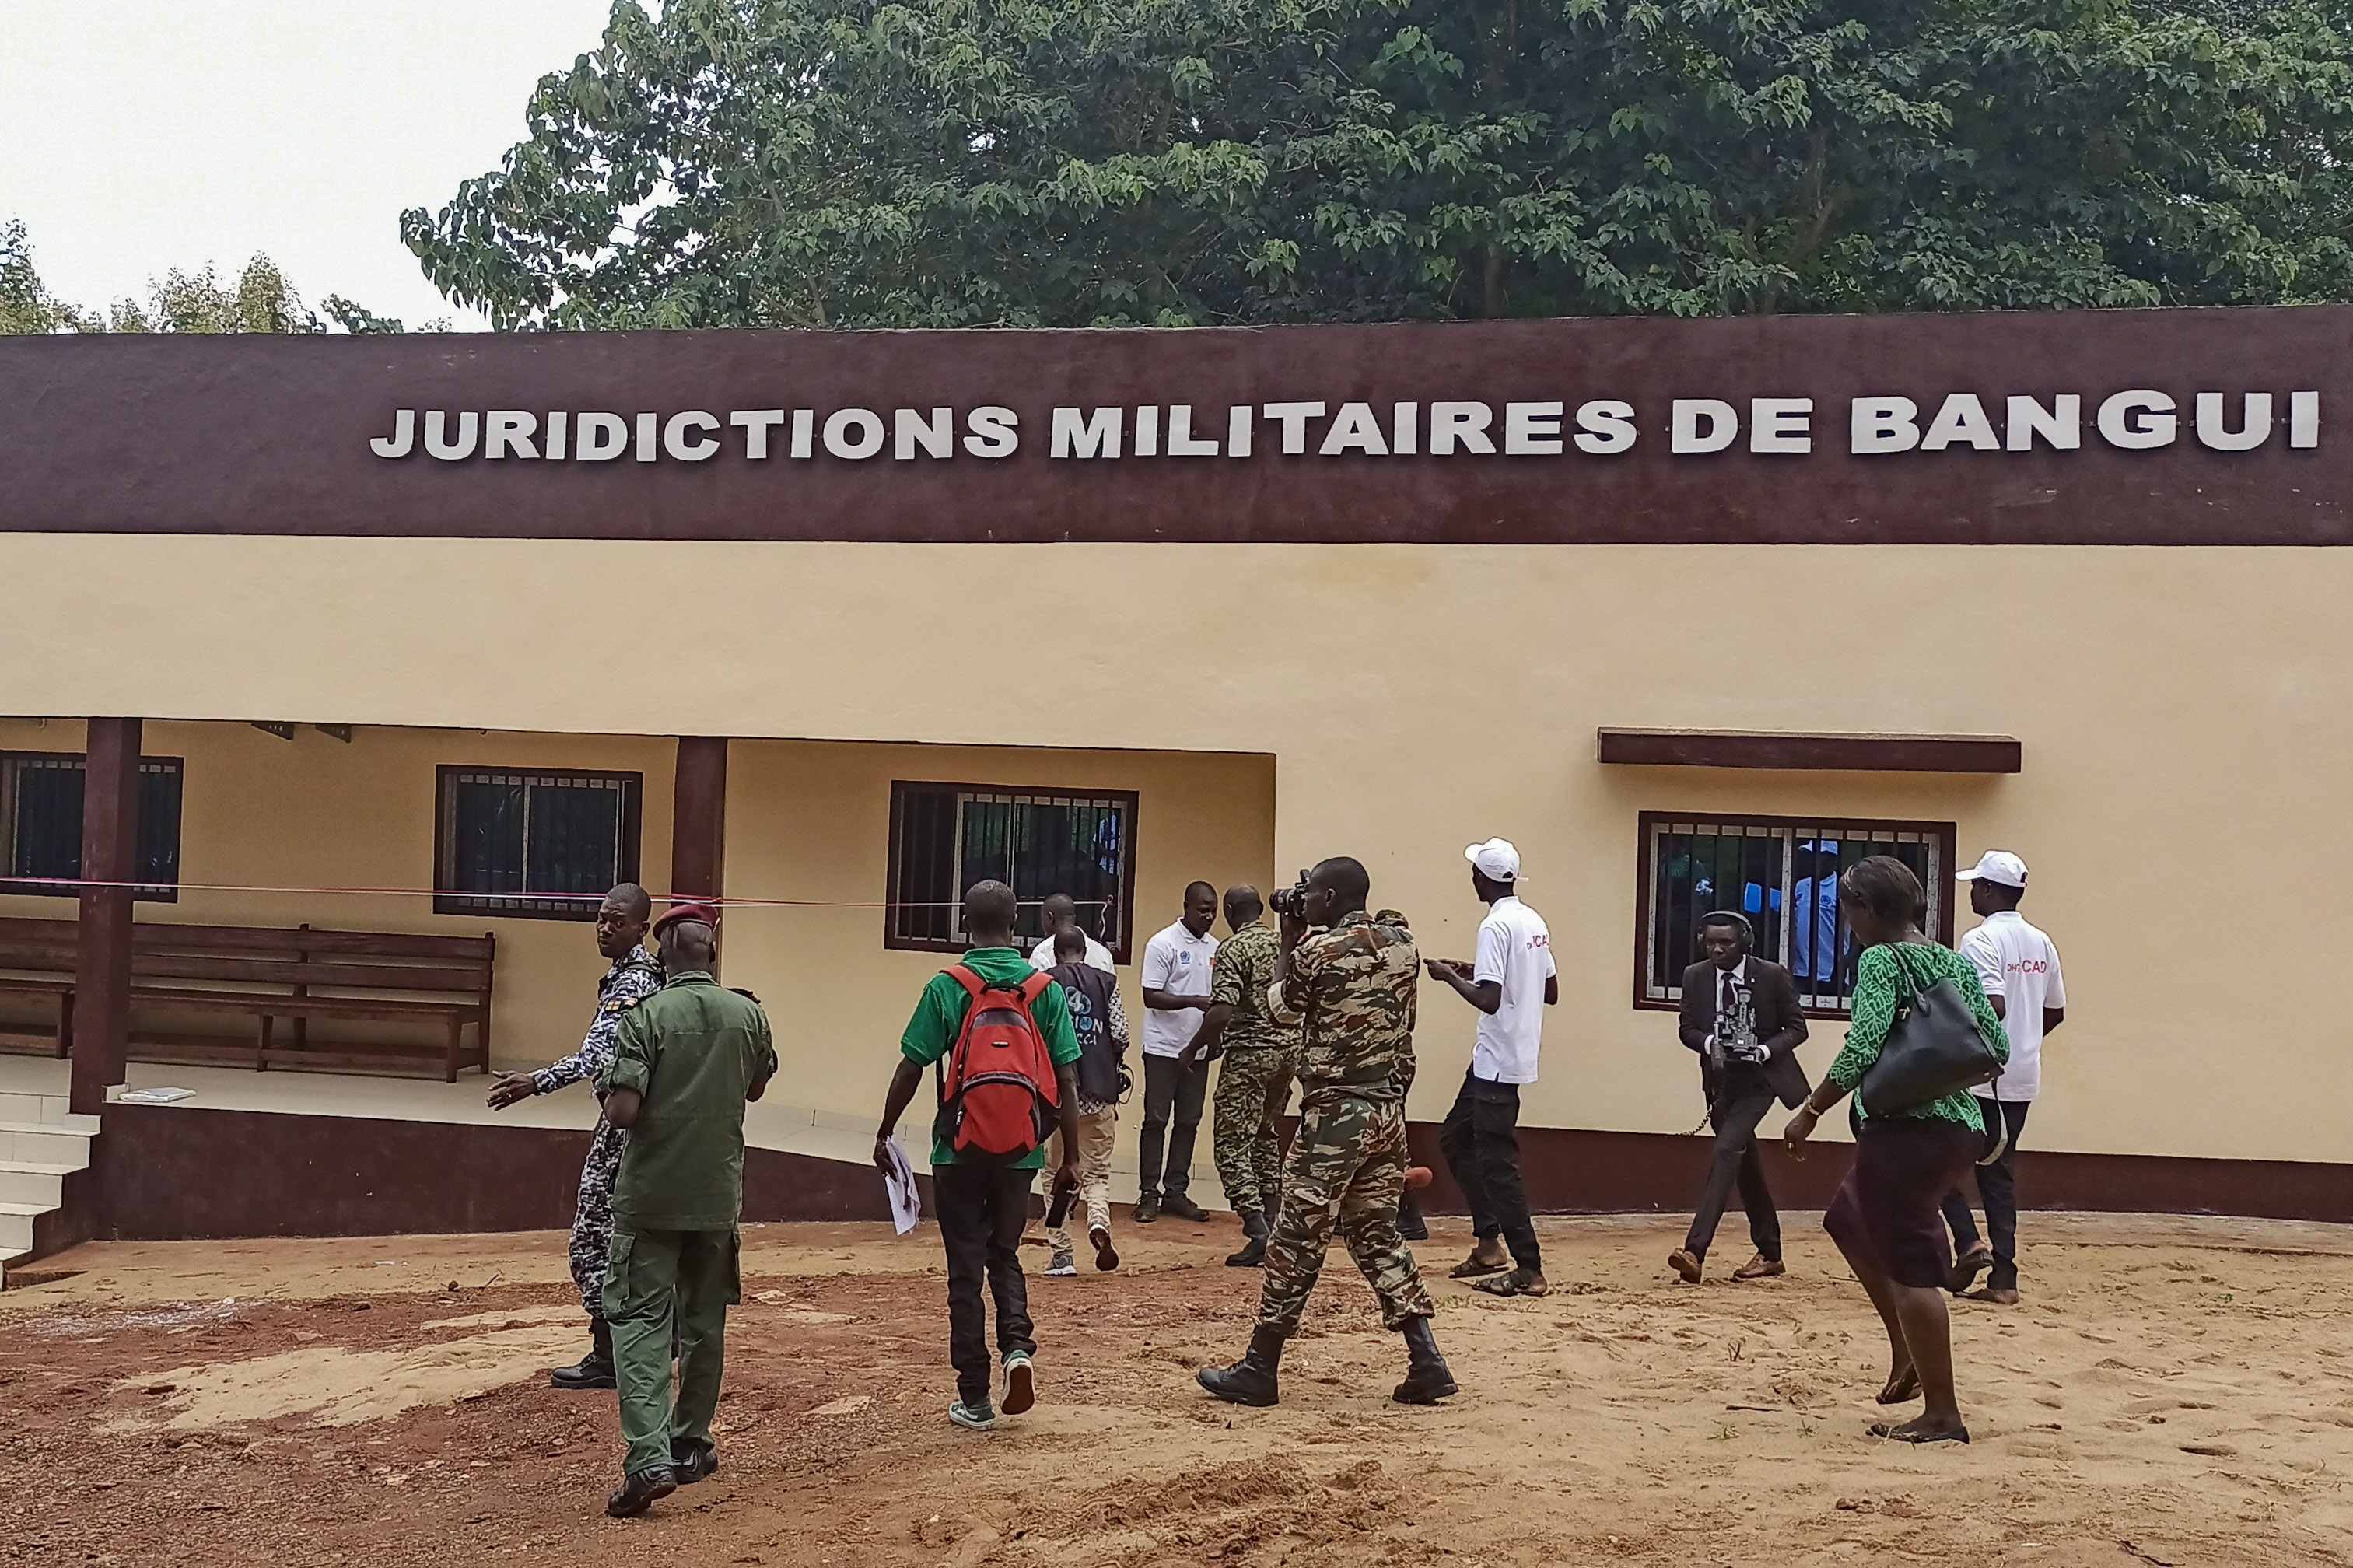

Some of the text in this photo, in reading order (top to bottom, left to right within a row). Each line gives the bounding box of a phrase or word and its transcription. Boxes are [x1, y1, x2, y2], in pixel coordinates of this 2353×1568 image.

[369, 390, 2320, 462] JURIDICTIONS MILITAIRES DE BANGUI
[2022, 959, 2047, 973] CAD
